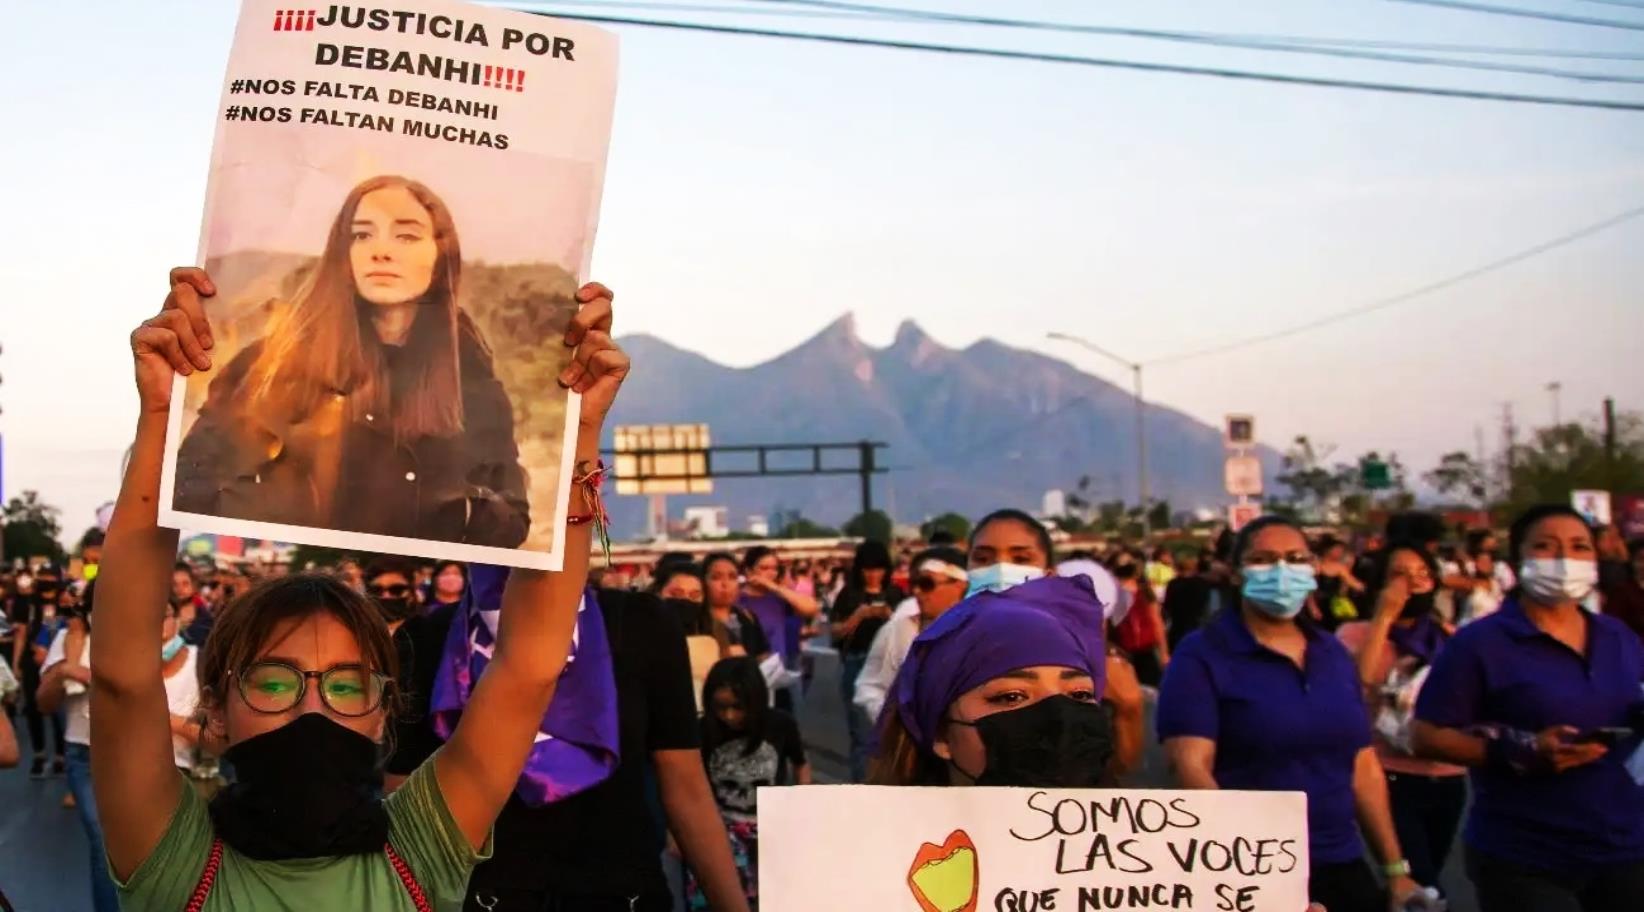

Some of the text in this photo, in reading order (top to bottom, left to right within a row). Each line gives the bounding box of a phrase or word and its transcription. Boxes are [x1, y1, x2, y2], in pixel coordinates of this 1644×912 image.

[501, 28, 576, 62] POR
[315, 43, 526, 93] DEBANHI!!!!
[230, 79, 498, 121] #NOS FALTA DEBANHI
[225, 105, 510, 151] #NOS FALTAN MUCHAS
[1009, 791, 1200, 841] SOMOS
[1055, 833, 1298, 875] LAS VOCES
[994, 884, 1261, 912] QUE NUNCA SE
